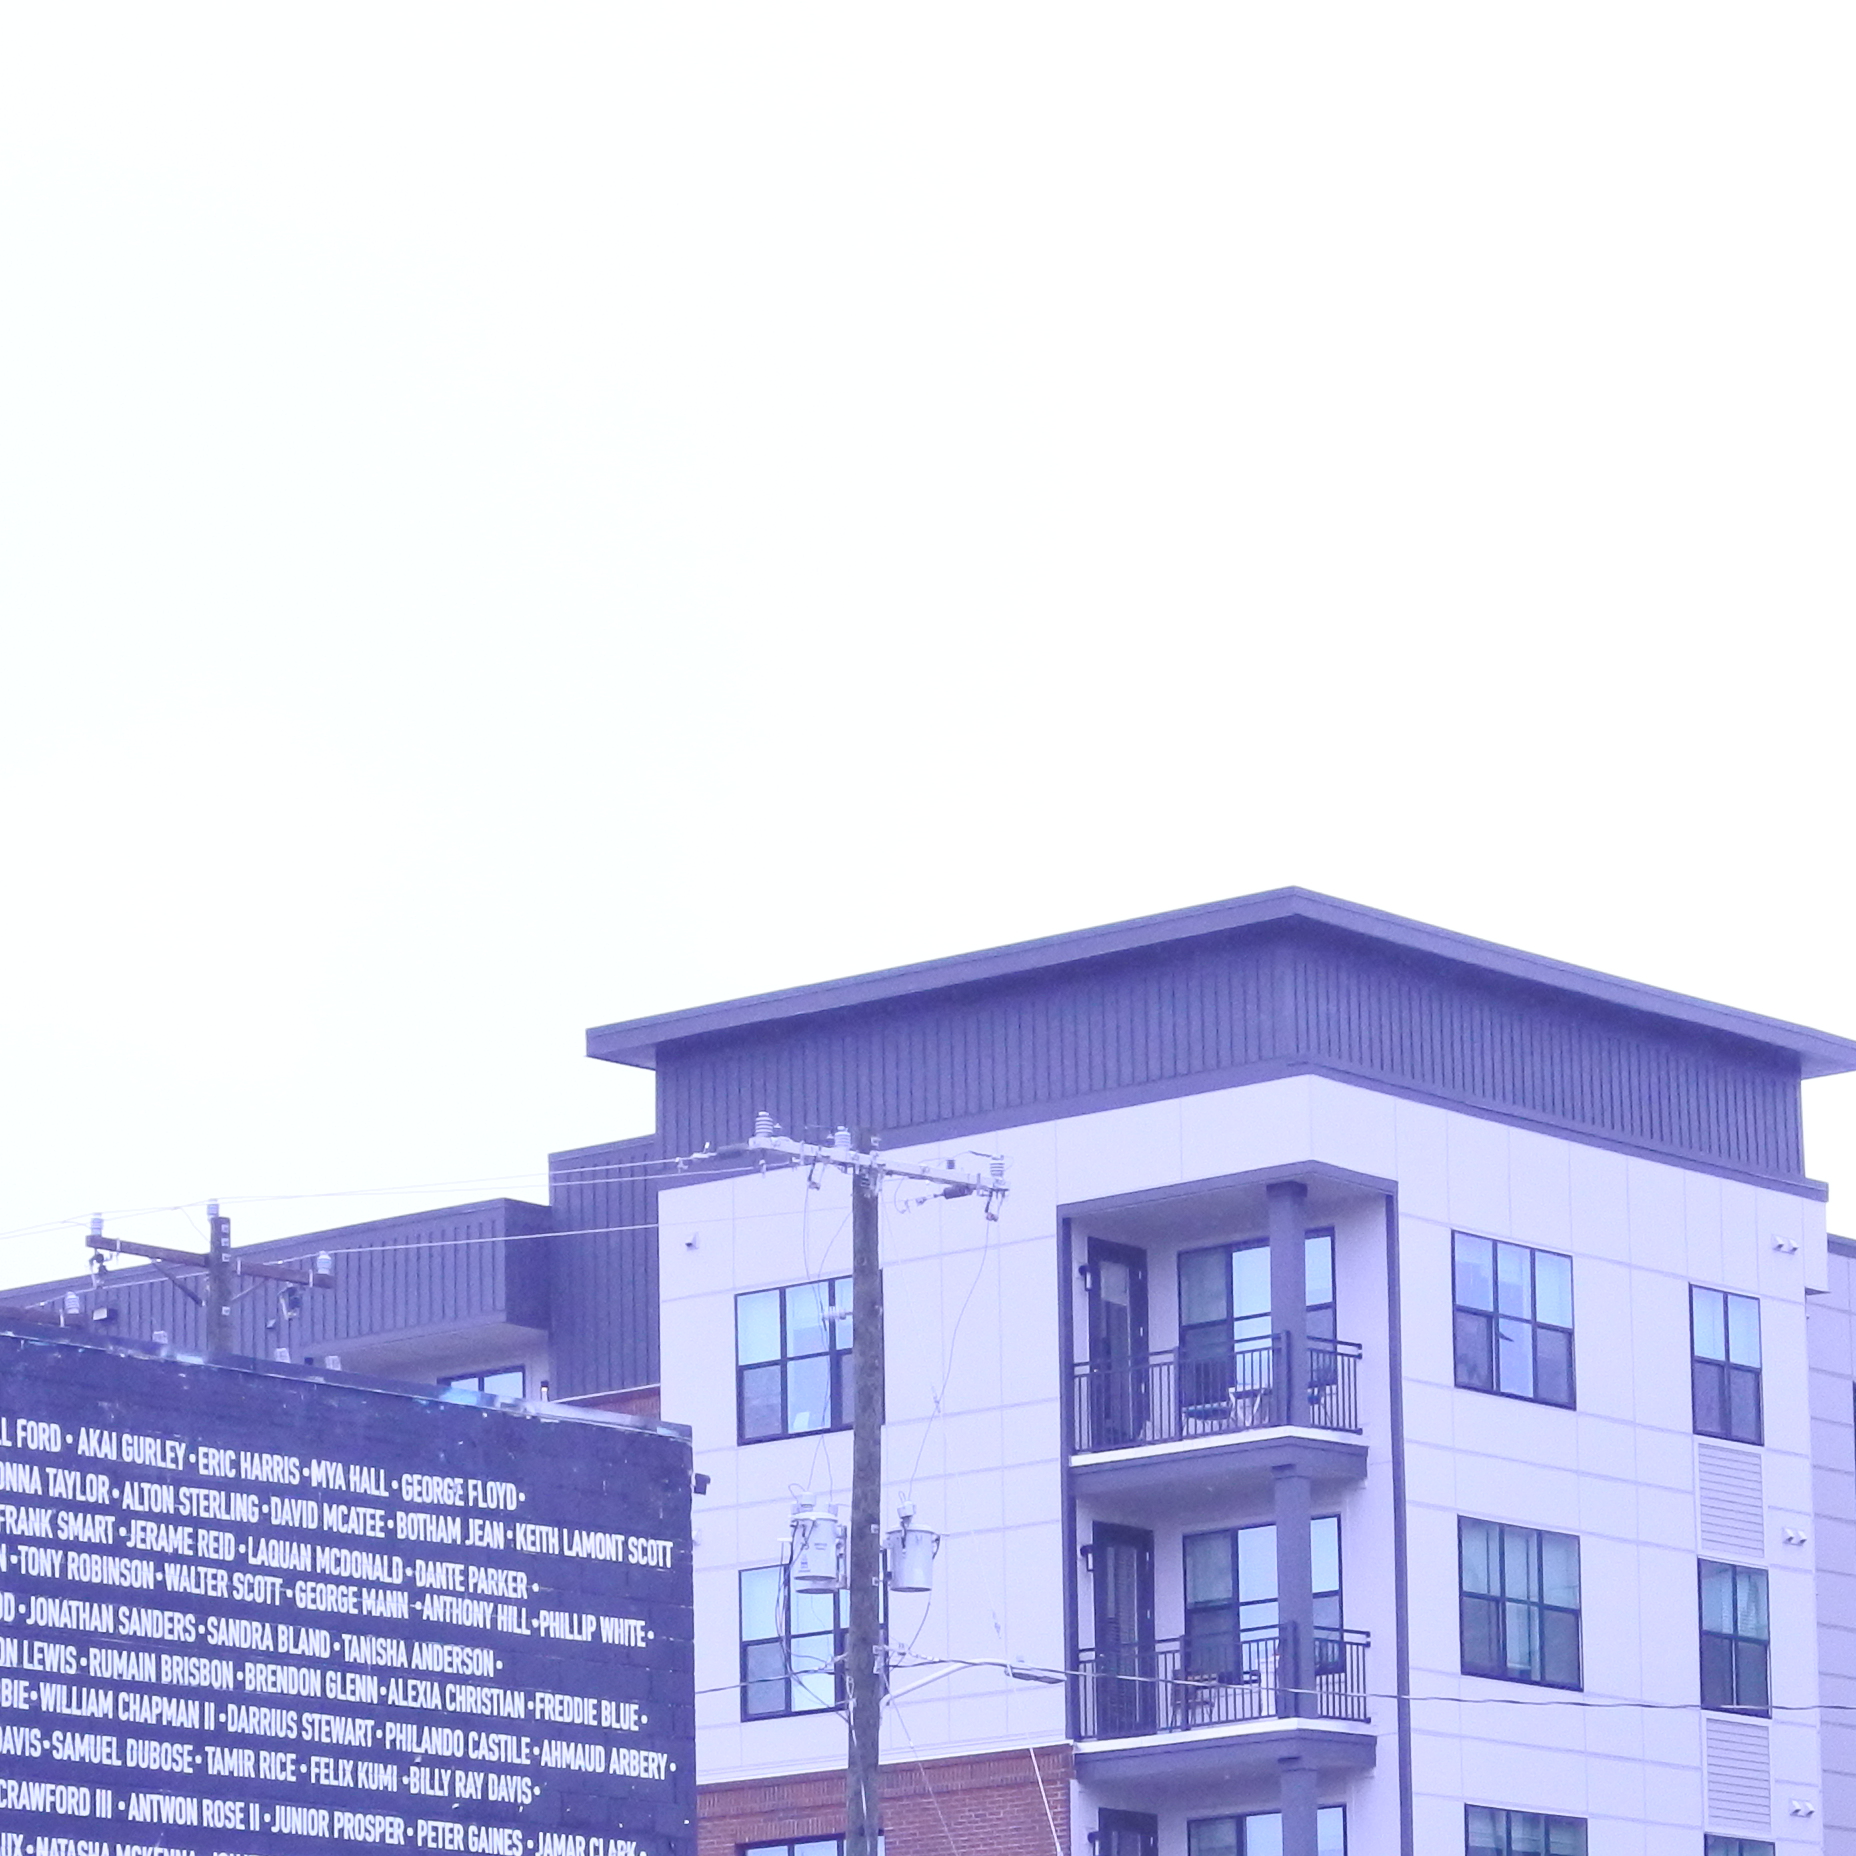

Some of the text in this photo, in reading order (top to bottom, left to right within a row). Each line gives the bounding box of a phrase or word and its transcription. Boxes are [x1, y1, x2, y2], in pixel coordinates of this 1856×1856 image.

[17, 1418, 61, 1452] FORD
[77, 1427, 117, 1460] AKAI
[122, 1434, 186, 1470] GURLEY
[198, 1446, 236, 1478] ERIC
[240, 1451, 300, 1485] HARRIS
[311, 1459, 346, 1490] MYA
[349, 1465, 389, 1497] HALL
[402, 1474, 464, 1506] GEORGE
[468, 1479, 517, 1510] FLOYD
[45, 1467, 109, 1504] TAYLOR
[122, 1481, 174, 1514] ALTON
[176, 1486, 259, 1523] STERLING
[270, 1496, 318, 1529] DAVID
[323, 1503, 385, 1538] MCATEE
[396, 1511, 461, 1545] BOTHAM
[465, 1518, 504, 1550] JEAN
[516, 1523, 559, 1554] KEITH
[563, 1528, 625, 1562] LAMONT
[628, 1536, 673, 1568] SCOTT
[57, 1511, 115, 1544] SMART
[128, 1519, 193, 1556] JERAME
[197, 1529, 235, 1561] REID
[248, 1536, 311, 1572] LAQUAN
[316, 1545, 403, 1584] MCDONALD
[415, 1559, 465, 1592] DANTE
[468, 1566, 528, 1599] PARKER
[18, 1545, 63, 1578] TONY
[67, 1551, 154, 1589] ROBINSON
[164, 1563, 228, 1598] WALTER
[233, 1572, 283, 1606] SCOTT
[295, 1580, 359, 1614] GEORGE
[362, 1588, 409, 1619] MANN
[421, 1593, 494, 1629] ANTHONY
[497, 1604, 531, 1635] HILL
[539, 1610, 596, 1641] PHILLIP
[600, 1616, 646, 1647] WHITE
[27, 1596, 114, 1633] JONATHAN
[118, 1606, 196, 1642] SANDERS
[207, 1616, 274, 1651] SANDRA
[278, 1624, 330, 1658] BLAND
[342, 1634, 408, 1668] TANISHA
[411, 1642, 494, 1677] ANDERSON
[23, 1640, 77, 1674] LEWIS
[89, 1648, 156, 1683] RUMAIN
[161, 1654, 233, 1691] BRISBON
[245, 1662, 321, 1697] BRENDON
[326, 1670, 378, 1704] GLENN
[388, 1678, 442, 1710] ALEXIA
[446, 1683, 525, 1719] CHRISTIAN
[535, 1692, 598, 1726] FREDDIE
[601, 1700, 639, 1731] BLUE
[40, 1682, 113, 1719] WILLIAM
[118, 1692, 199, 1729] CHAPMAN
[204, 1702, 215, 1730] II
[227, 1704, 297, 1739] DARRIUS
[302, 1712, 375, 1747] STEWART
[385, 1722, 464, 1758] PHILANDO
[468, 1731, 531, 1765] CASTILE
[541, 1739, 605, 1773] AHMAUD
[609, 1747, 667, 1780] ARBERY
[52, 1730, 122, 1766] SAMUEL
[126, 1738, 193, 1773] DUBOSE
[205, 1746, 255, 1778] TAMIR
[259, 1750, 296, 1782] RICE
[311, 1756, 354, 1787] FELIX
[358, 1761, 397, 1792] KUMI
[409, 1766, 451, 1796] BILLY
[455, 1770, 484, 1799] RAY
[488, 1773, 532, 1804] DAVIS
[96, 1789, 112, 1819] III
[128, 1793, 198, 1826] ANTWON
[202, 1799, 245, 1830] ROSE
[249, 1803, 260, 1831] II
[271, 1805, 329, 1838] JUNIOR
[334, 1811, 405, 1845] PROSPER
[417, 1819, 464, 1851] PETER
[468, 1825, 523, 1856] GAINES
